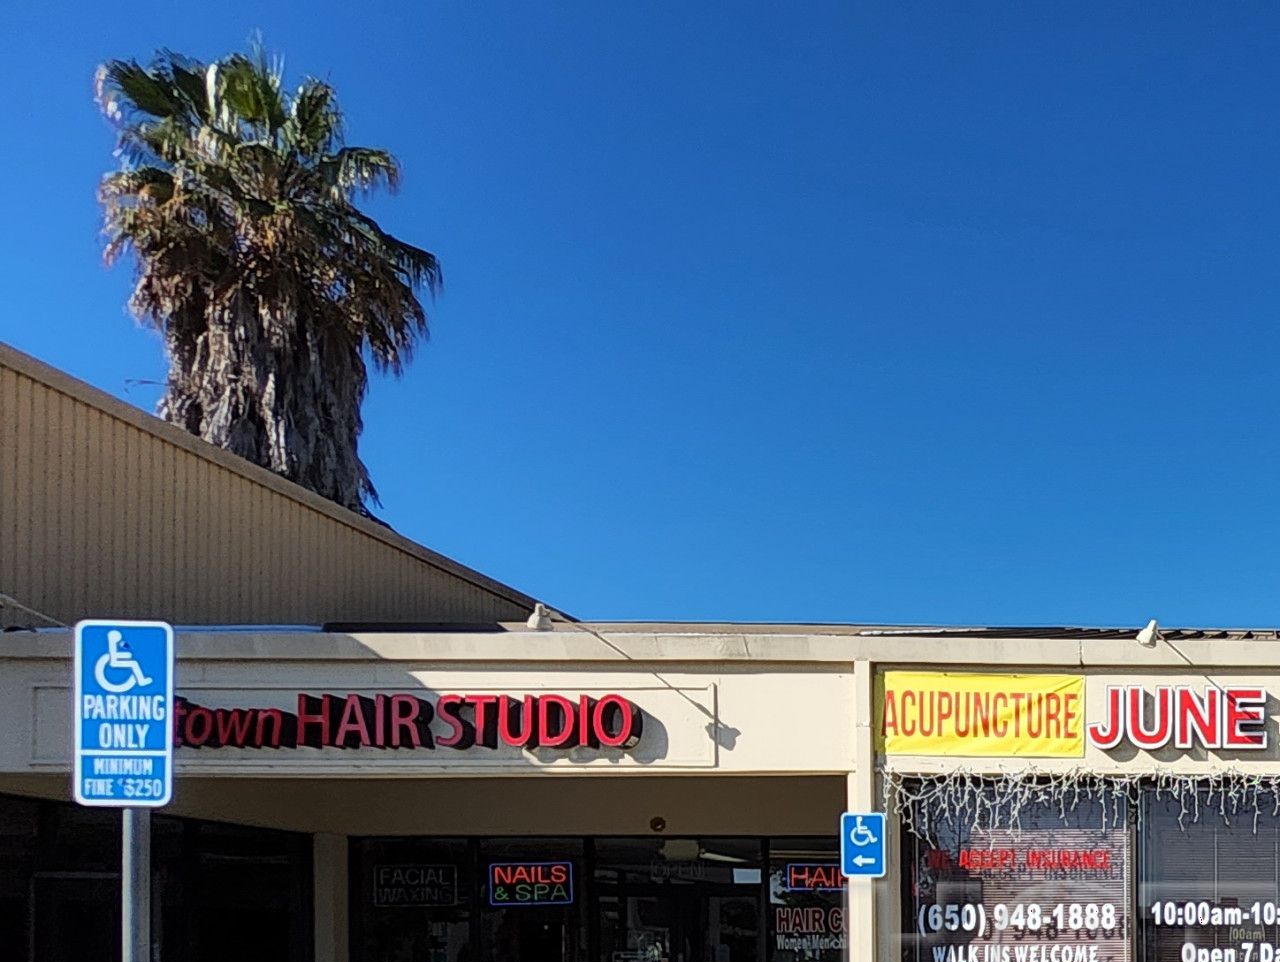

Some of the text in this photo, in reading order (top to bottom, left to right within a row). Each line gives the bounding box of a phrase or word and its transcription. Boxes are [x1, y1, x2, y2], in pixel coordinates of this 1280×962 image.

[83, 694, 165, 721] PARKING
[882, 689, 1077, 739] ACUPUNCTURE
[1088, 684, 1269, 750] JUNE
[298, 694, 422, 747] HAIR
[436, 694, 633, 747] STUDIO
[99, 722, 149, 748] ONLY
[94, 758, 153, 777] MINIMUM
[84, 778, 163, 797] FINE $250
[959, 849, 1016, 869] ACCEPT
[1026, 849, 1110, 869] INSURANCE
[380, 868, 451, 885] FACIAL
[494, 865, 567, 884] NAILS
[381, 887, 453, 903] WAXING
[494, 884, 568, 901] & SPA
[776, 908, 826, 933] HAIR
[918, 903, 1116, 937] (650) 948-1888
